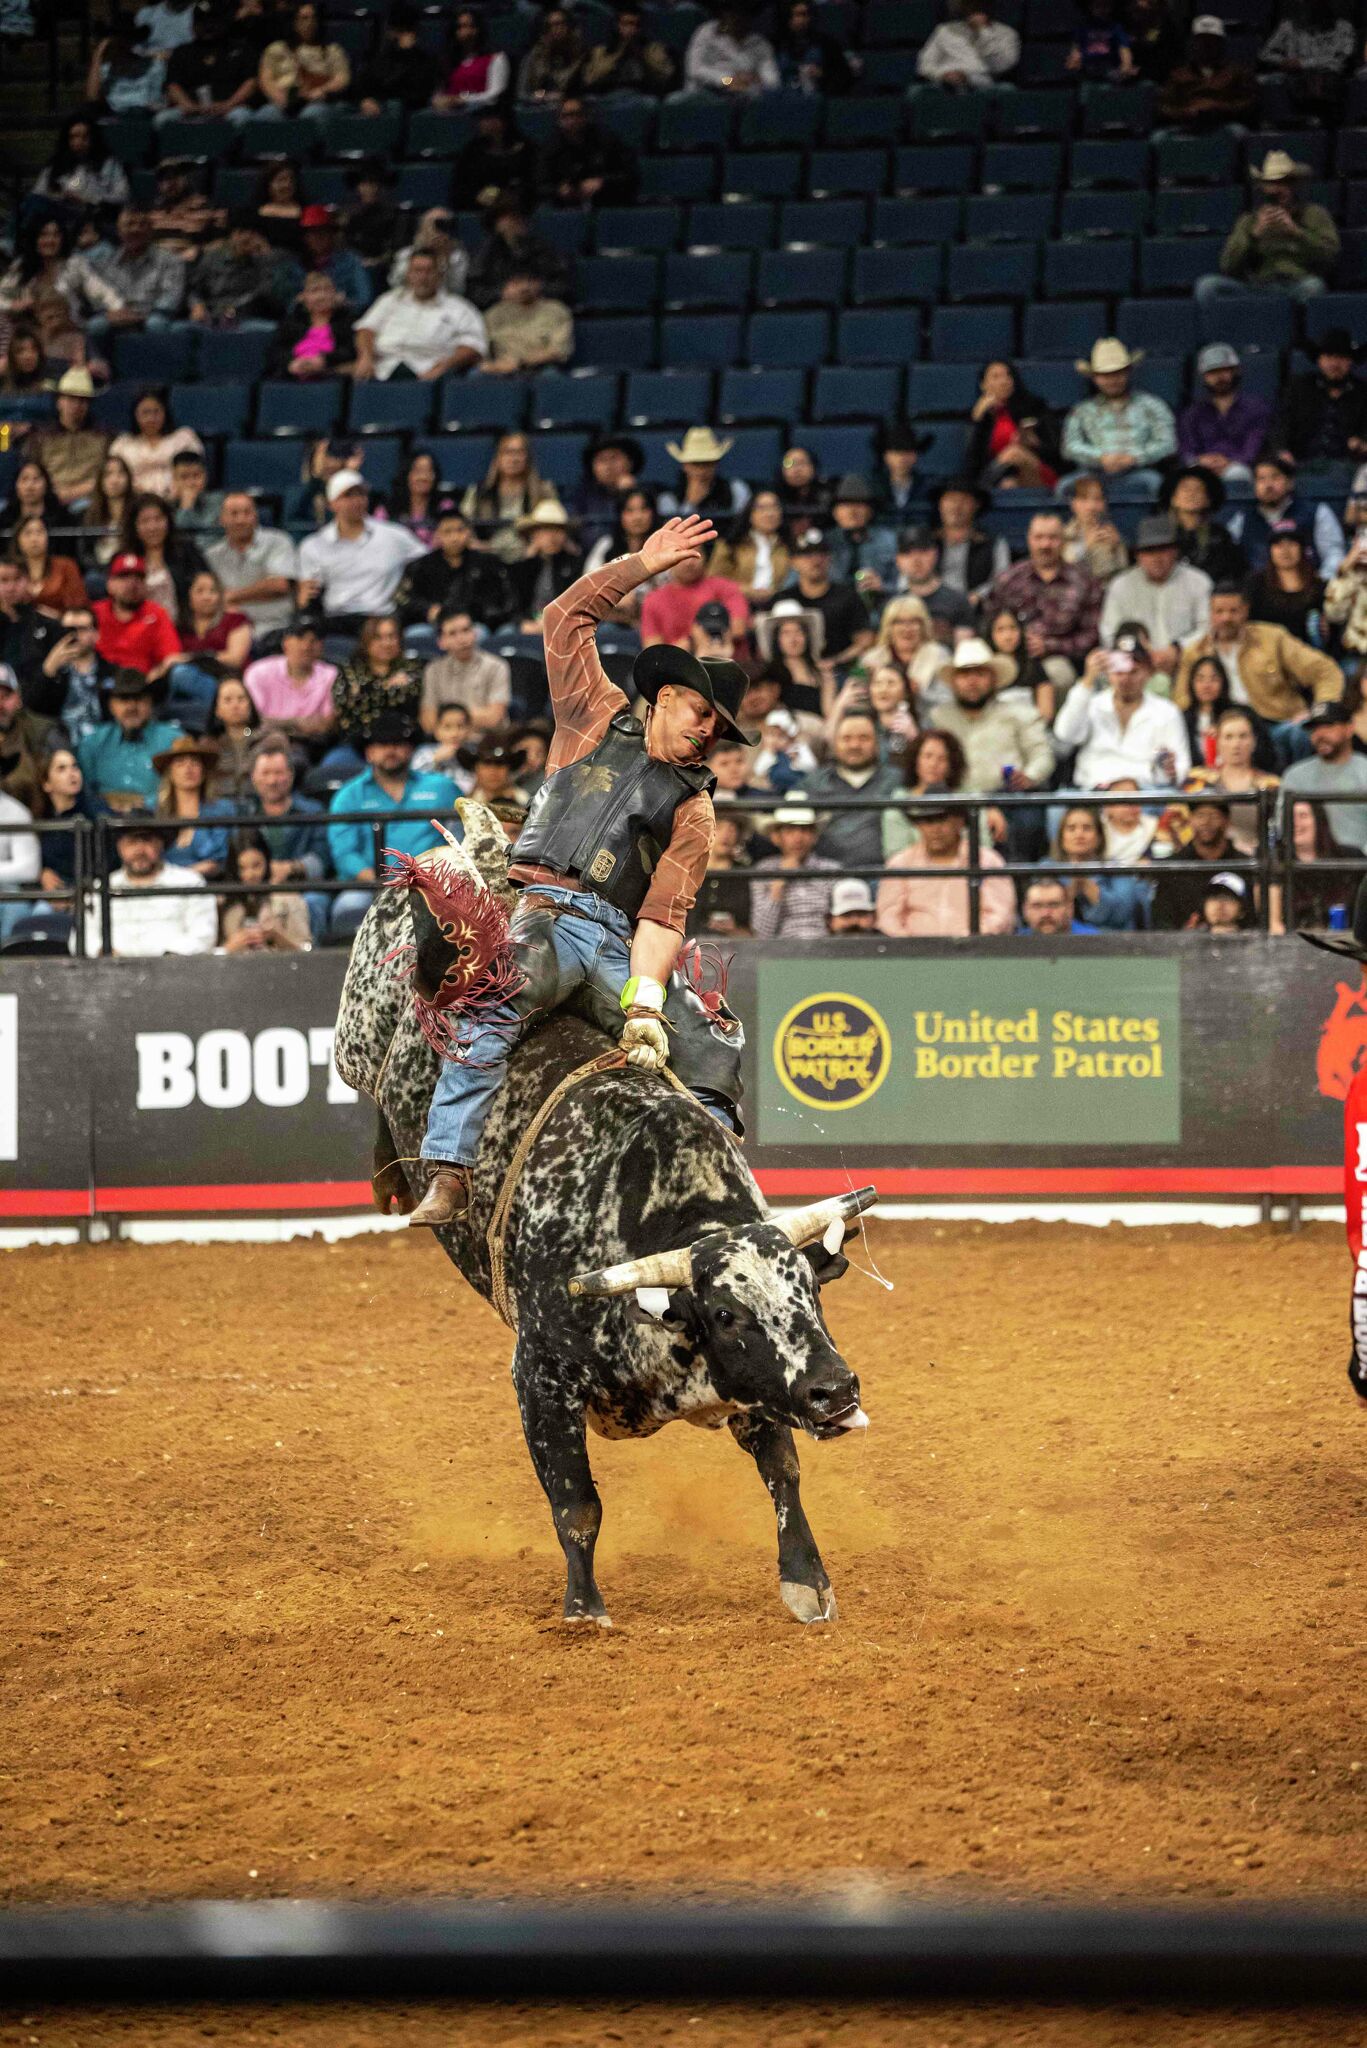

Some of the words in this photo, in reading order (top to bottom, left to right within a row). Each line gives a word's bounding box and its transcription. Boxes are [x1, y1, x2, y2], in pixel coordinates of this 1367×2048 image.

[914, 1009, 1039, 1042] United
[1051, 1010, 1161, 1042] States
[788, 1036, 876, 1057] BORDER
[914, 1045, 1039, 1079] Border
[1052, 1044, 1162, 1078] Patrol
[135, 1027, 359, 1109] BOOT
[789, 1057, 874, 1080] PATROL
